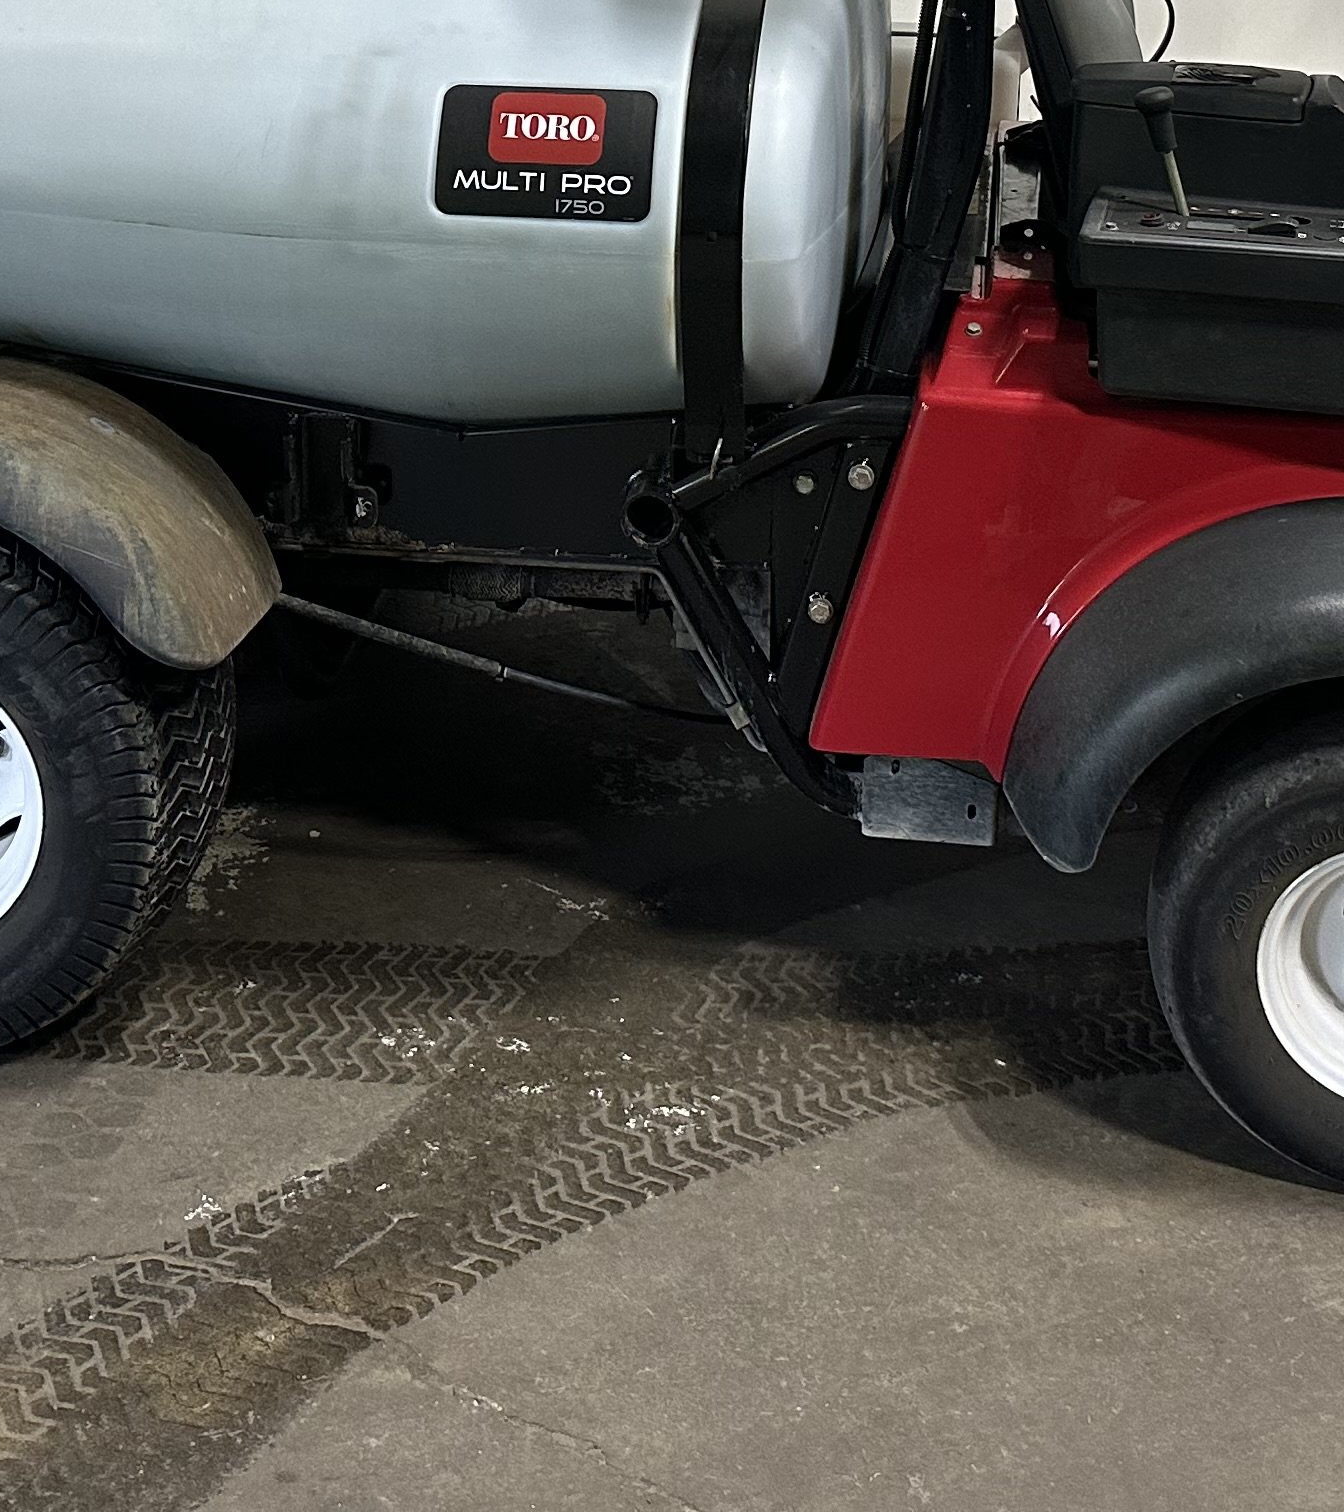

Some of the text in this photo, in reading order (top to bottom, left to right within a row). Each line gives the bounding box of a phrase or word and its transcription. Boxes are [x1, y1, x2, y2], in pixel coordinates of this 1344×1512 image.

[499, 112, 598, 142] TORO
[453, 169, 633, 196] MULTI PRO
[555, 199, 605, 215] 1750
